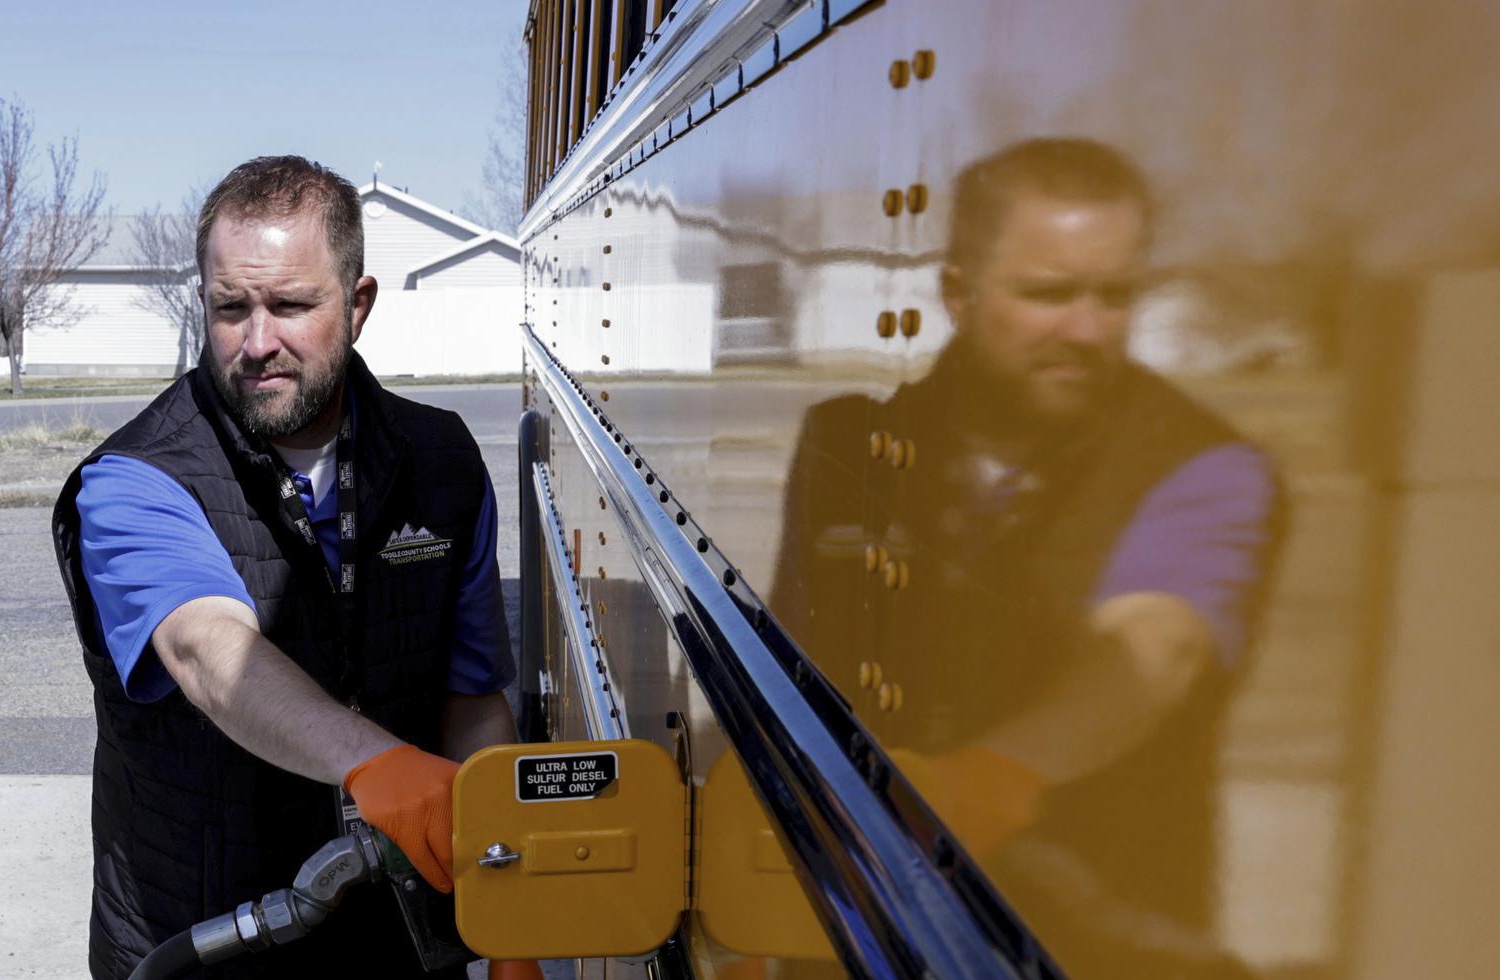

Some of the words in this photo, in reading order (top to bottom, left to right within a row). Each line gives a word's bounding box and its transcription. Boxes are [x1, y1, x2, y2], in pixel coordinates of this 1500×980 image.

[401, 548, 423, 557] COUNTY
[423, 542, 452, 554] SCHOOLS
[388, 551, 445, 565] TRANSPORTATION
[536, 761, 568, 773] ULTRA
[573, 760, 597, 771] LOW
[527, 772, 566, 785] SULFUR
[572, 771, 608, 782] DIESEL
[537, 785, 563, 795] FUEL
[569, 783, 596, 794] ONLY
